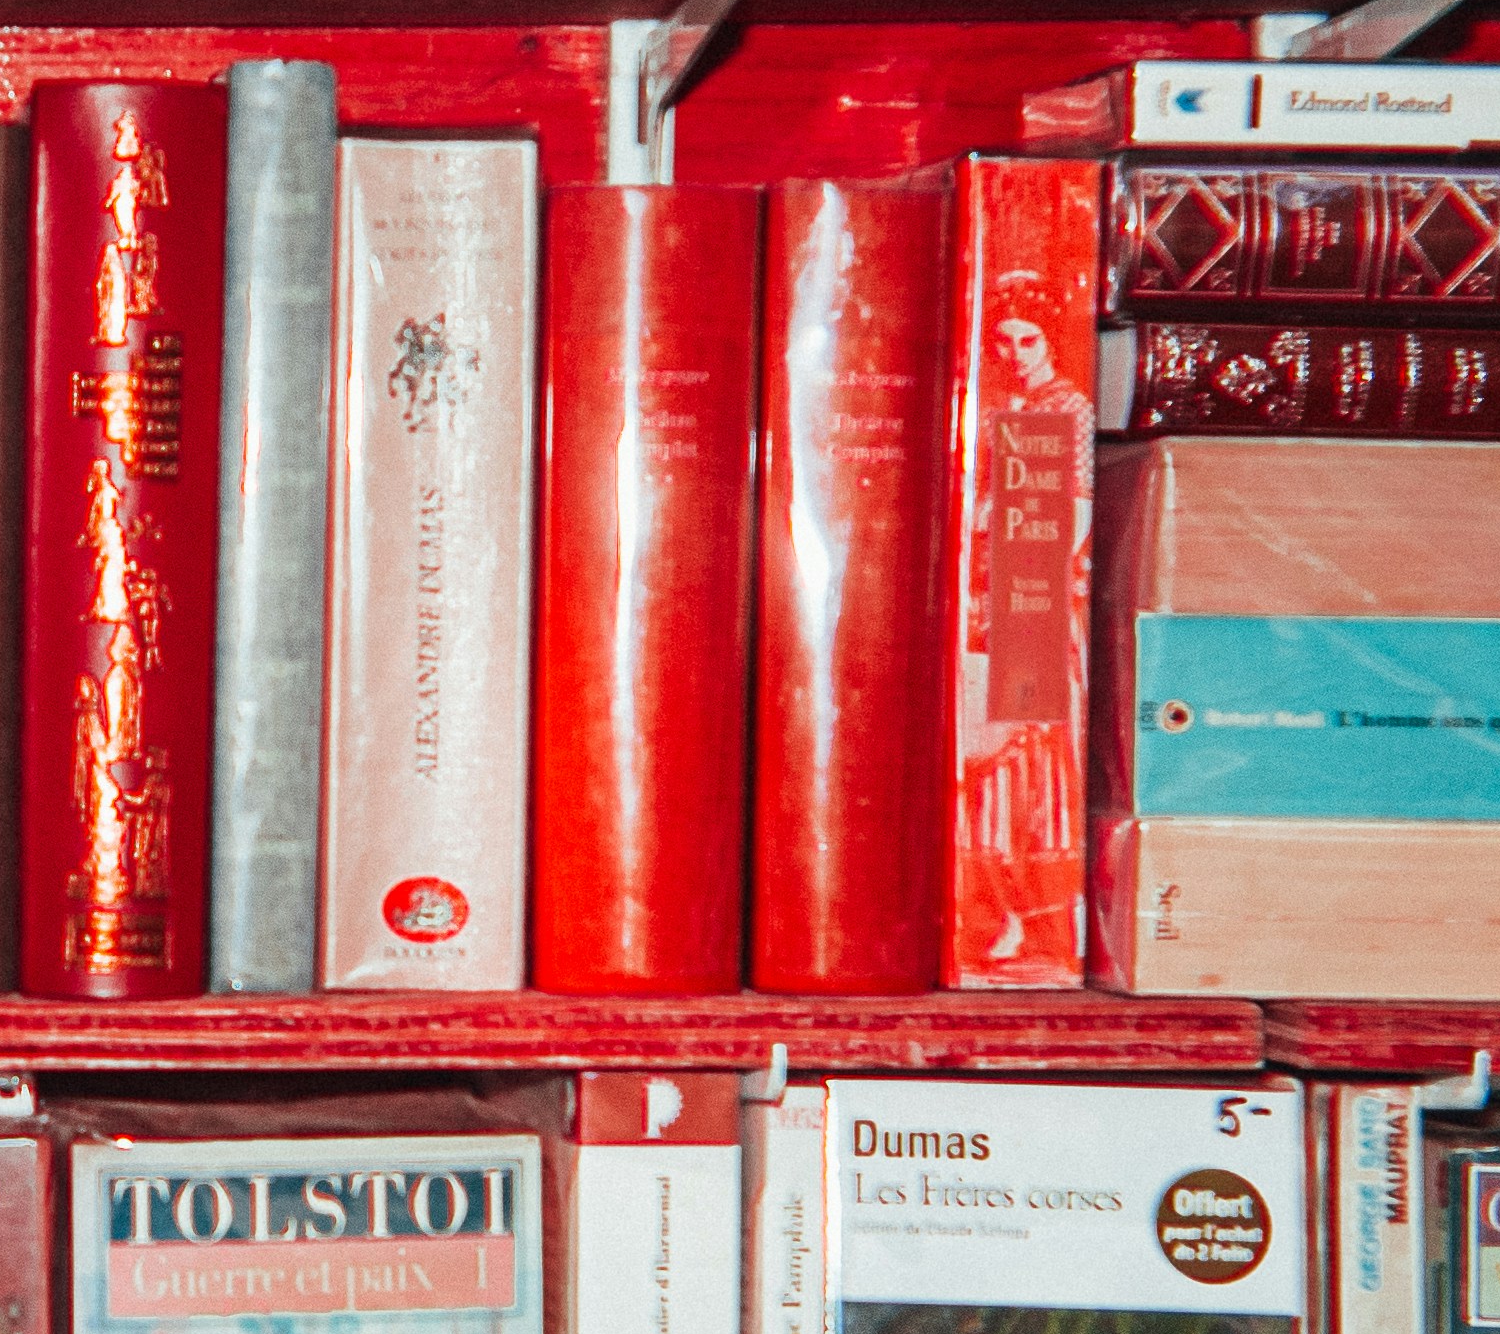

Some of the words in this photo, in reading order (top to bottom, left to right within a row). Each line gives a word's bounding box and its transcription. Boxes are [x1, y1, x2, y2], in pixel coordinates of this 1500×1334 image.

[1288, 90, 1370, 115] Edmond
[1000, 421, 1067, 456] NOTRE
[1006, 457, 1064, 491] DAME
[1006, 507, 1060, 542] PARIS
[413, 604, 442, 784] ALEXANDRE
[852, 1118, 991, 1162] Dumas
[1384, 1103, 1411, 1225] MAUPRAT
[854, 1172, 907, 1208] Les
[921, 1172, 1016, 1210] Frères
[1027, 1183, 1125, 1213] corses
[1173, 1188, 1253, 1220] Offert
[132, 1251, 283, 1303] Guerre
[294, 1255, 334, 1300] et
[342, 1249, 436, 1313] paix
